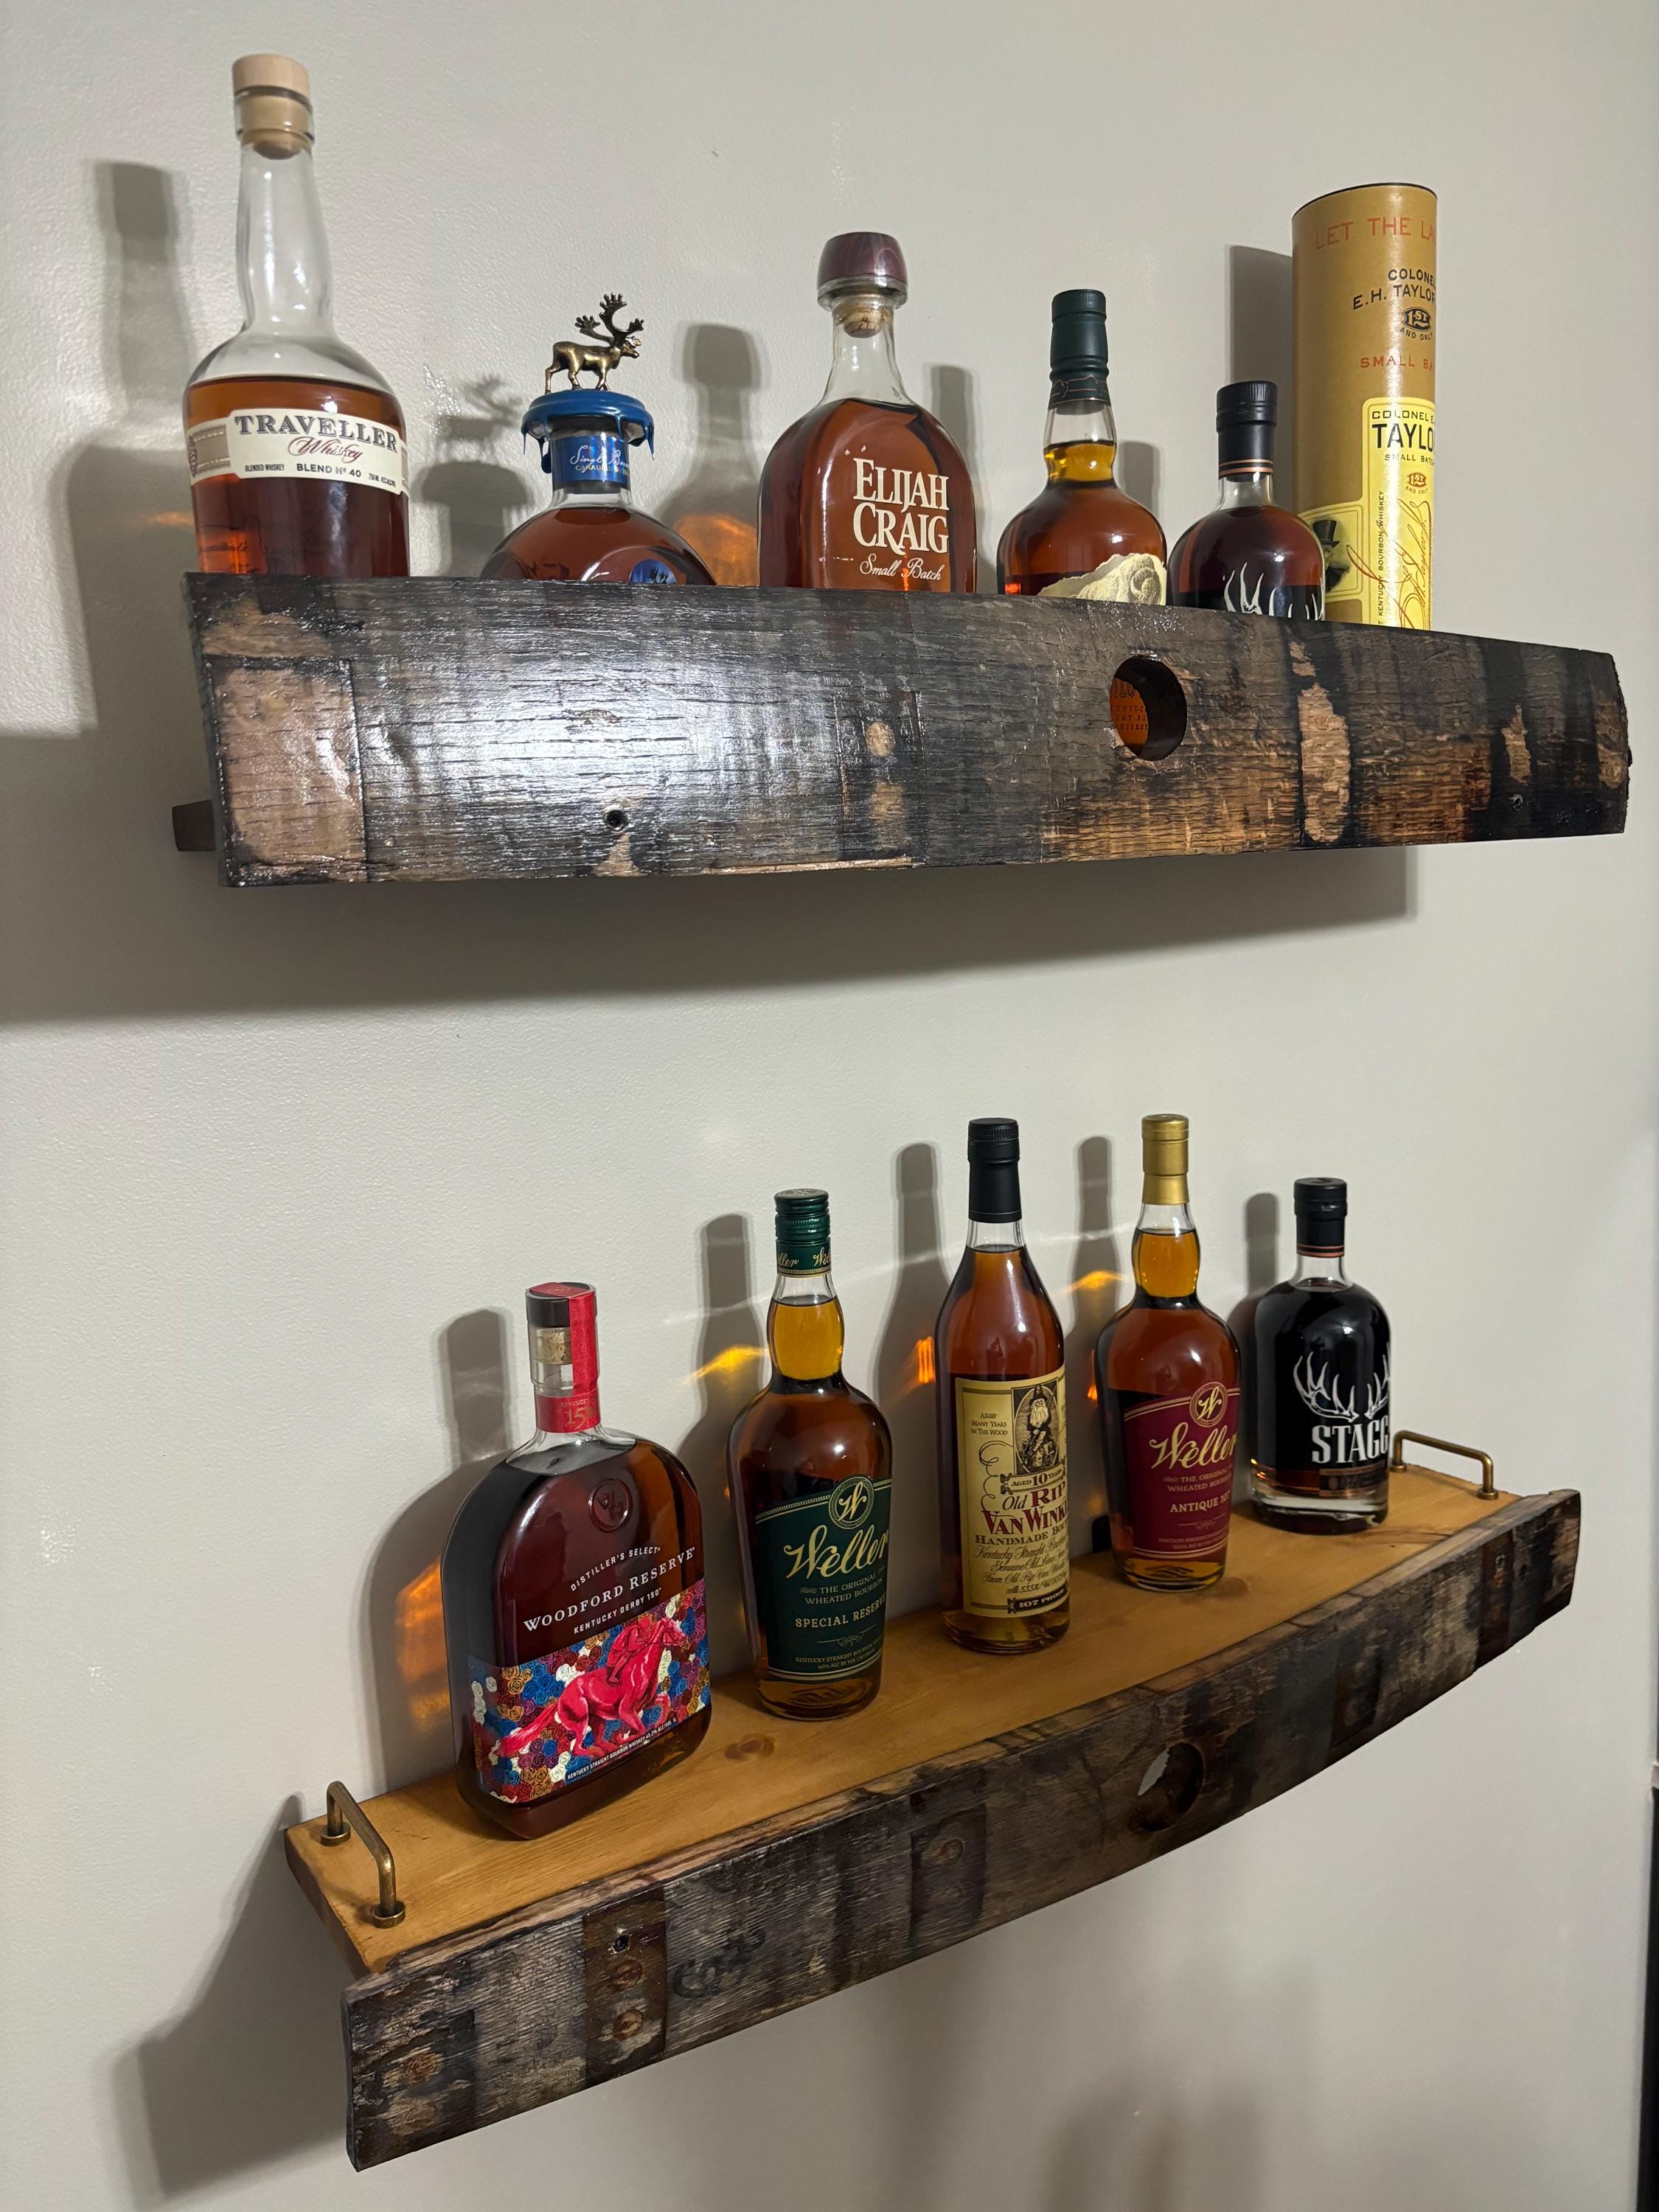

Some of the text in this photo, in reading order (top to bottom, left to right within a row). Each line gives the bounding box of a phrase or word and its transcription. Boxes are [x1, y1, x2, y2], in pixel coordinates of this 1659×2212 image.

[1316, 218, 1436, 249] LET THE LA
[1353, 288, 1387, 310] E.H.
[1401, 328, 1416, 339] AND
[1360, 355, 1415, 368] SMALL
[1371, 410, 1428, 422] COLONEL
[234, 414, 398, 453] TRAVELLER
[1371, 423, 1435, 453] TAYLO
[288, 437, 363, 463] Whiskey
[1421, 456, 1435, 466] BATC
[296, 463, 332, 473] BLEND
[349, 468, 361, 478] 40
[853, 457, 950, 513] ELIJAH
[853, 502, 949, 555] CRAIG
[860, 553, 945, 580] Small Batch
[1149, 1422, 1237, 1470] Weller
[1032, 1472, 1048, 1486] 10
[1167, 1483, 1208, 1492] WHEATED
[1180, 1475, 1197, 1483] THE
[1002, 1481, 1066, 1511] Old RIP
[1169, 1498, 1219, 1514] ANTIQUE
[981, 1510, 1023, 1535] VAN
[975, 1531, 1048, 1545] HANDMADE
[783, 1524, 889, 1579] Weller
[974, 1545, 1014, 1565] Kentucky
[571, 1547, 659, 1591] DISTILLER'S SELECT
[524, 1547, 694, 1632] WOODFORD RESERVE
[819, 1571, 876, 1594] THE ORIGINAL
[804, 1592, 852, 1604] WHEATED
[1019, 1600, 1039, 1608] 107
[574, 1610, 617, 1634] KENTUCKY
[620, 1598, 645, 1614] DERBY
[795, 1615, 849, 1628] SPECIAL
[568, 1766, 589, 1779] KENTUCKY
[589, 1754, 610, 1770] STRAIGHT
[610, 1745, 628, 1759] BOURBON
[628, 1737, 646, 1750] WHISKEY
